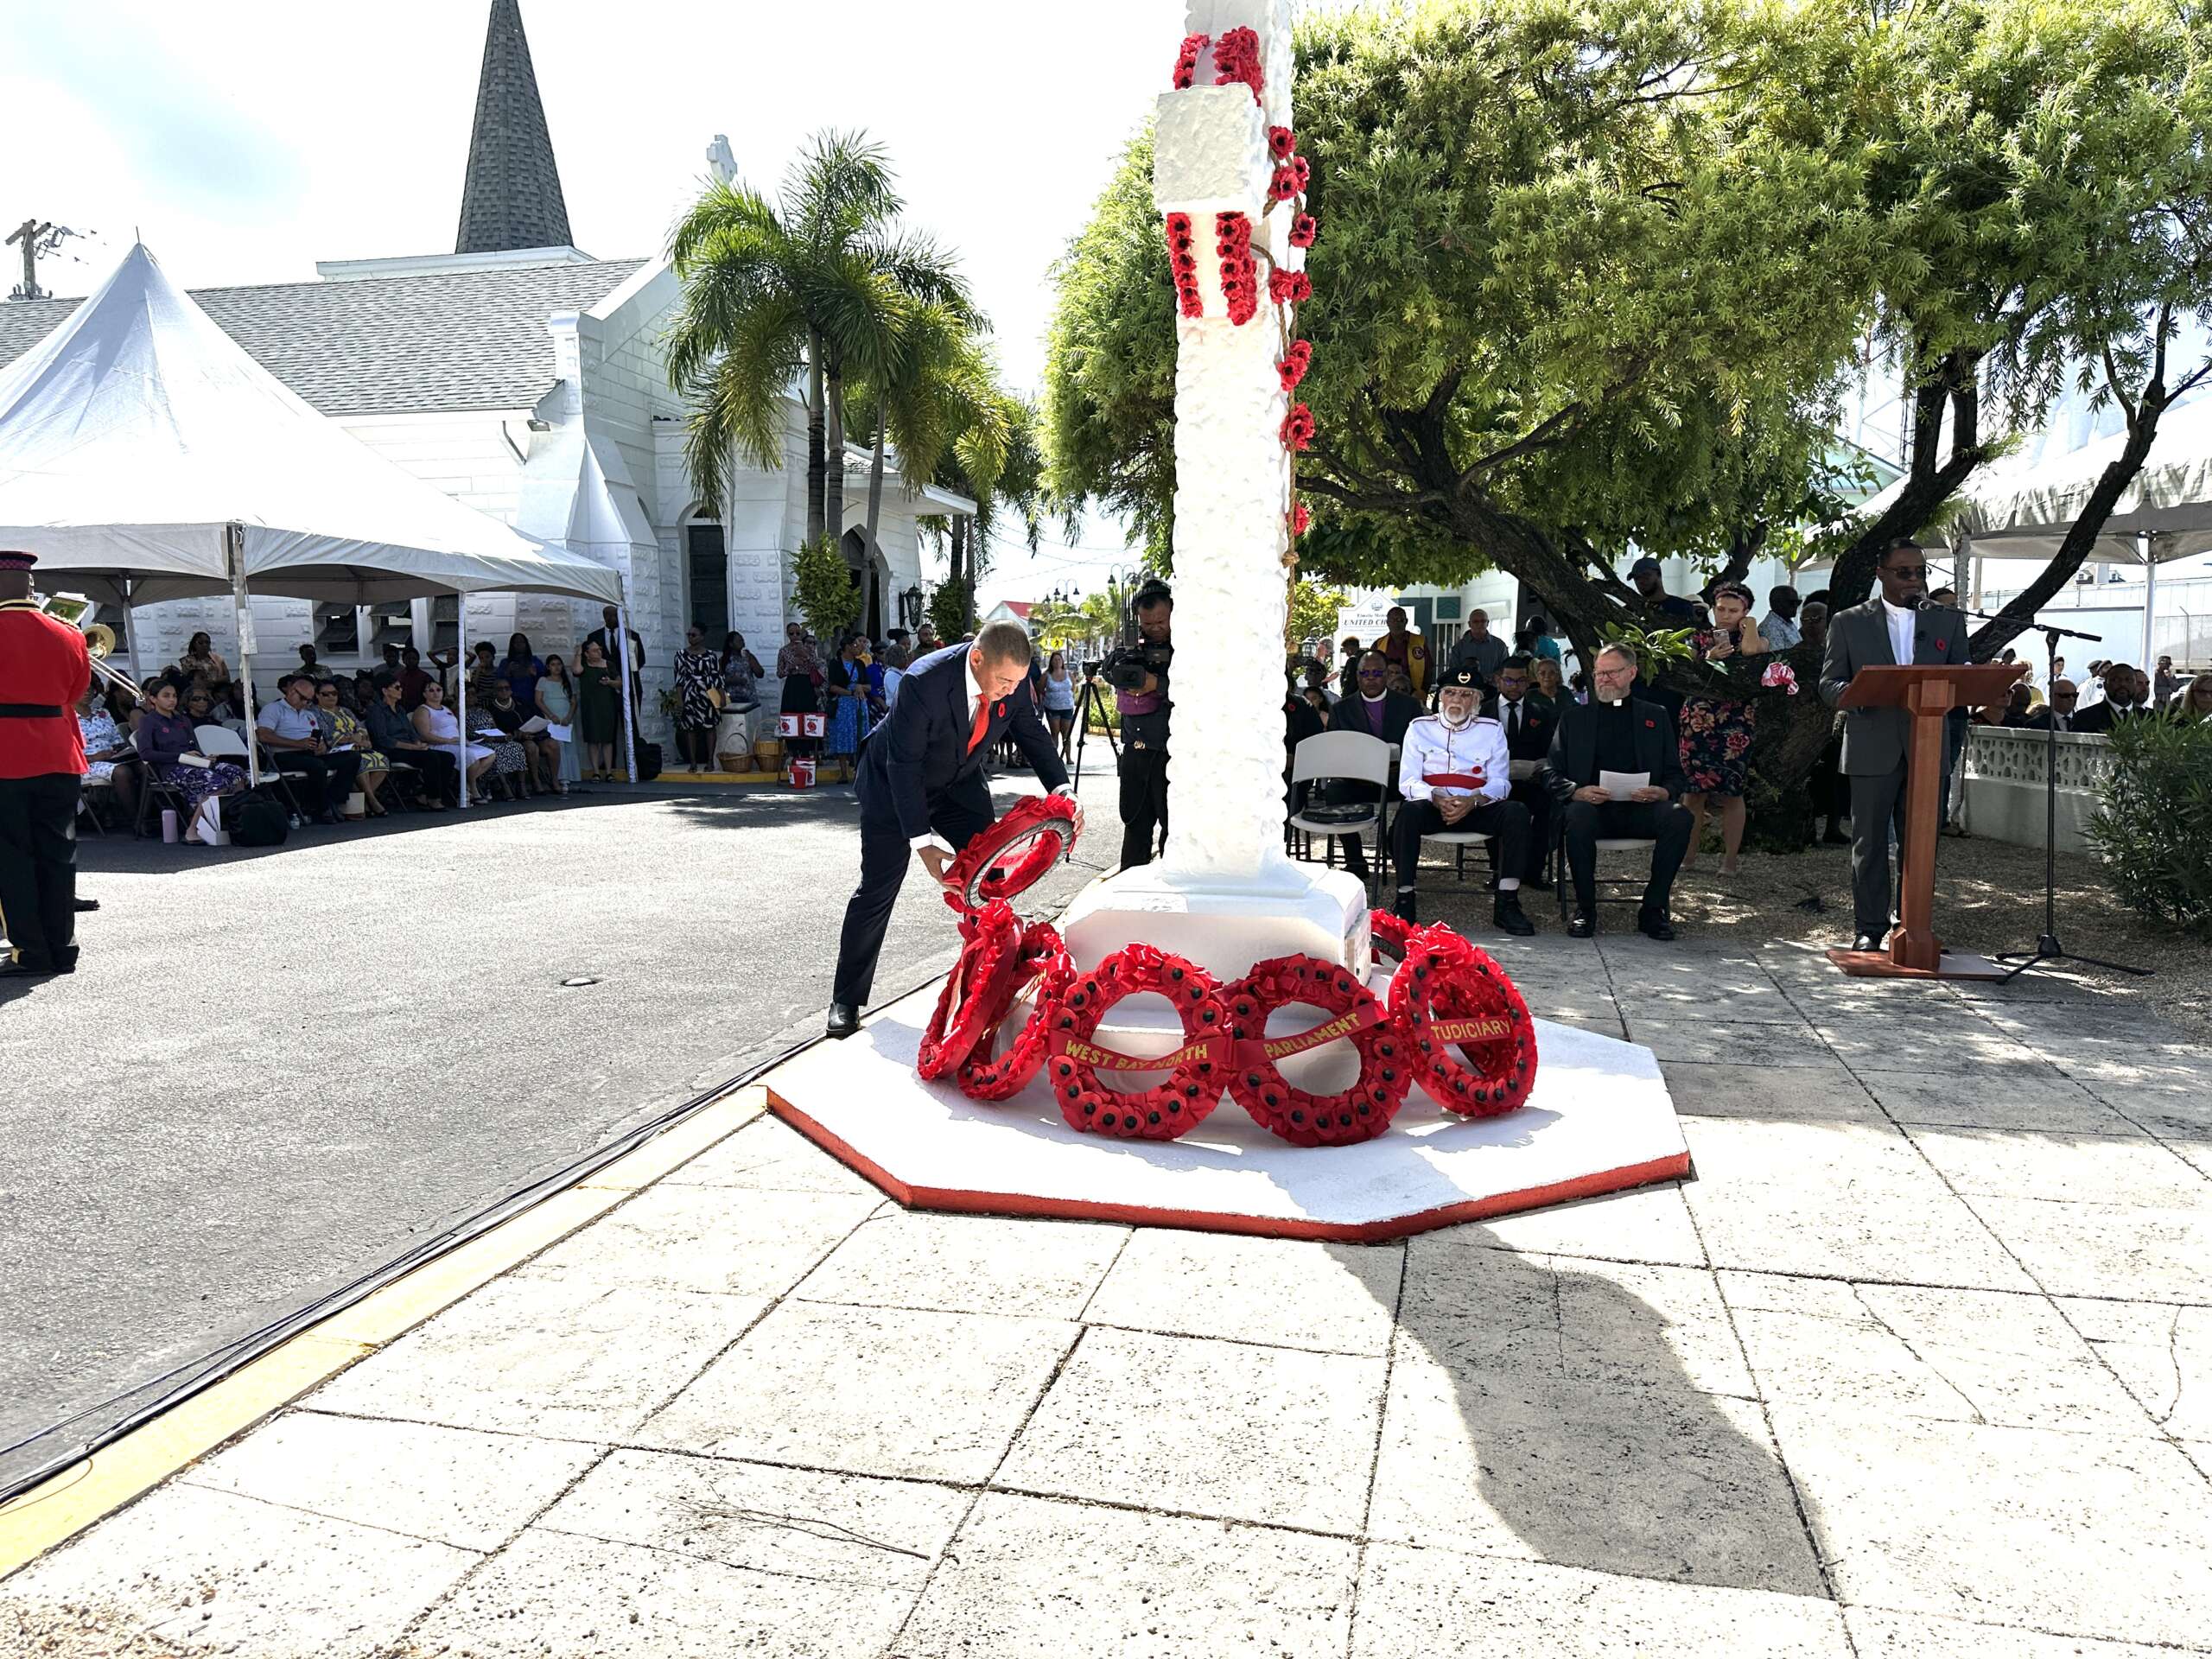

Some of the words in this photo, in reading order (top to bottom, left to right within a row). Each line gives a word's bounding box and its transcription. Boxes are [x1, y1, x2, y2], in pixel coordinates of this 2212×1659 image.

[1263, 1012, 1361, 1058] PARLIAMENT
[1065, 1039, 1114, 1066] WEST
[1115, 1057, 1150, 1070] BAY
[1153, 1043, 1208, 1069] NORTH
